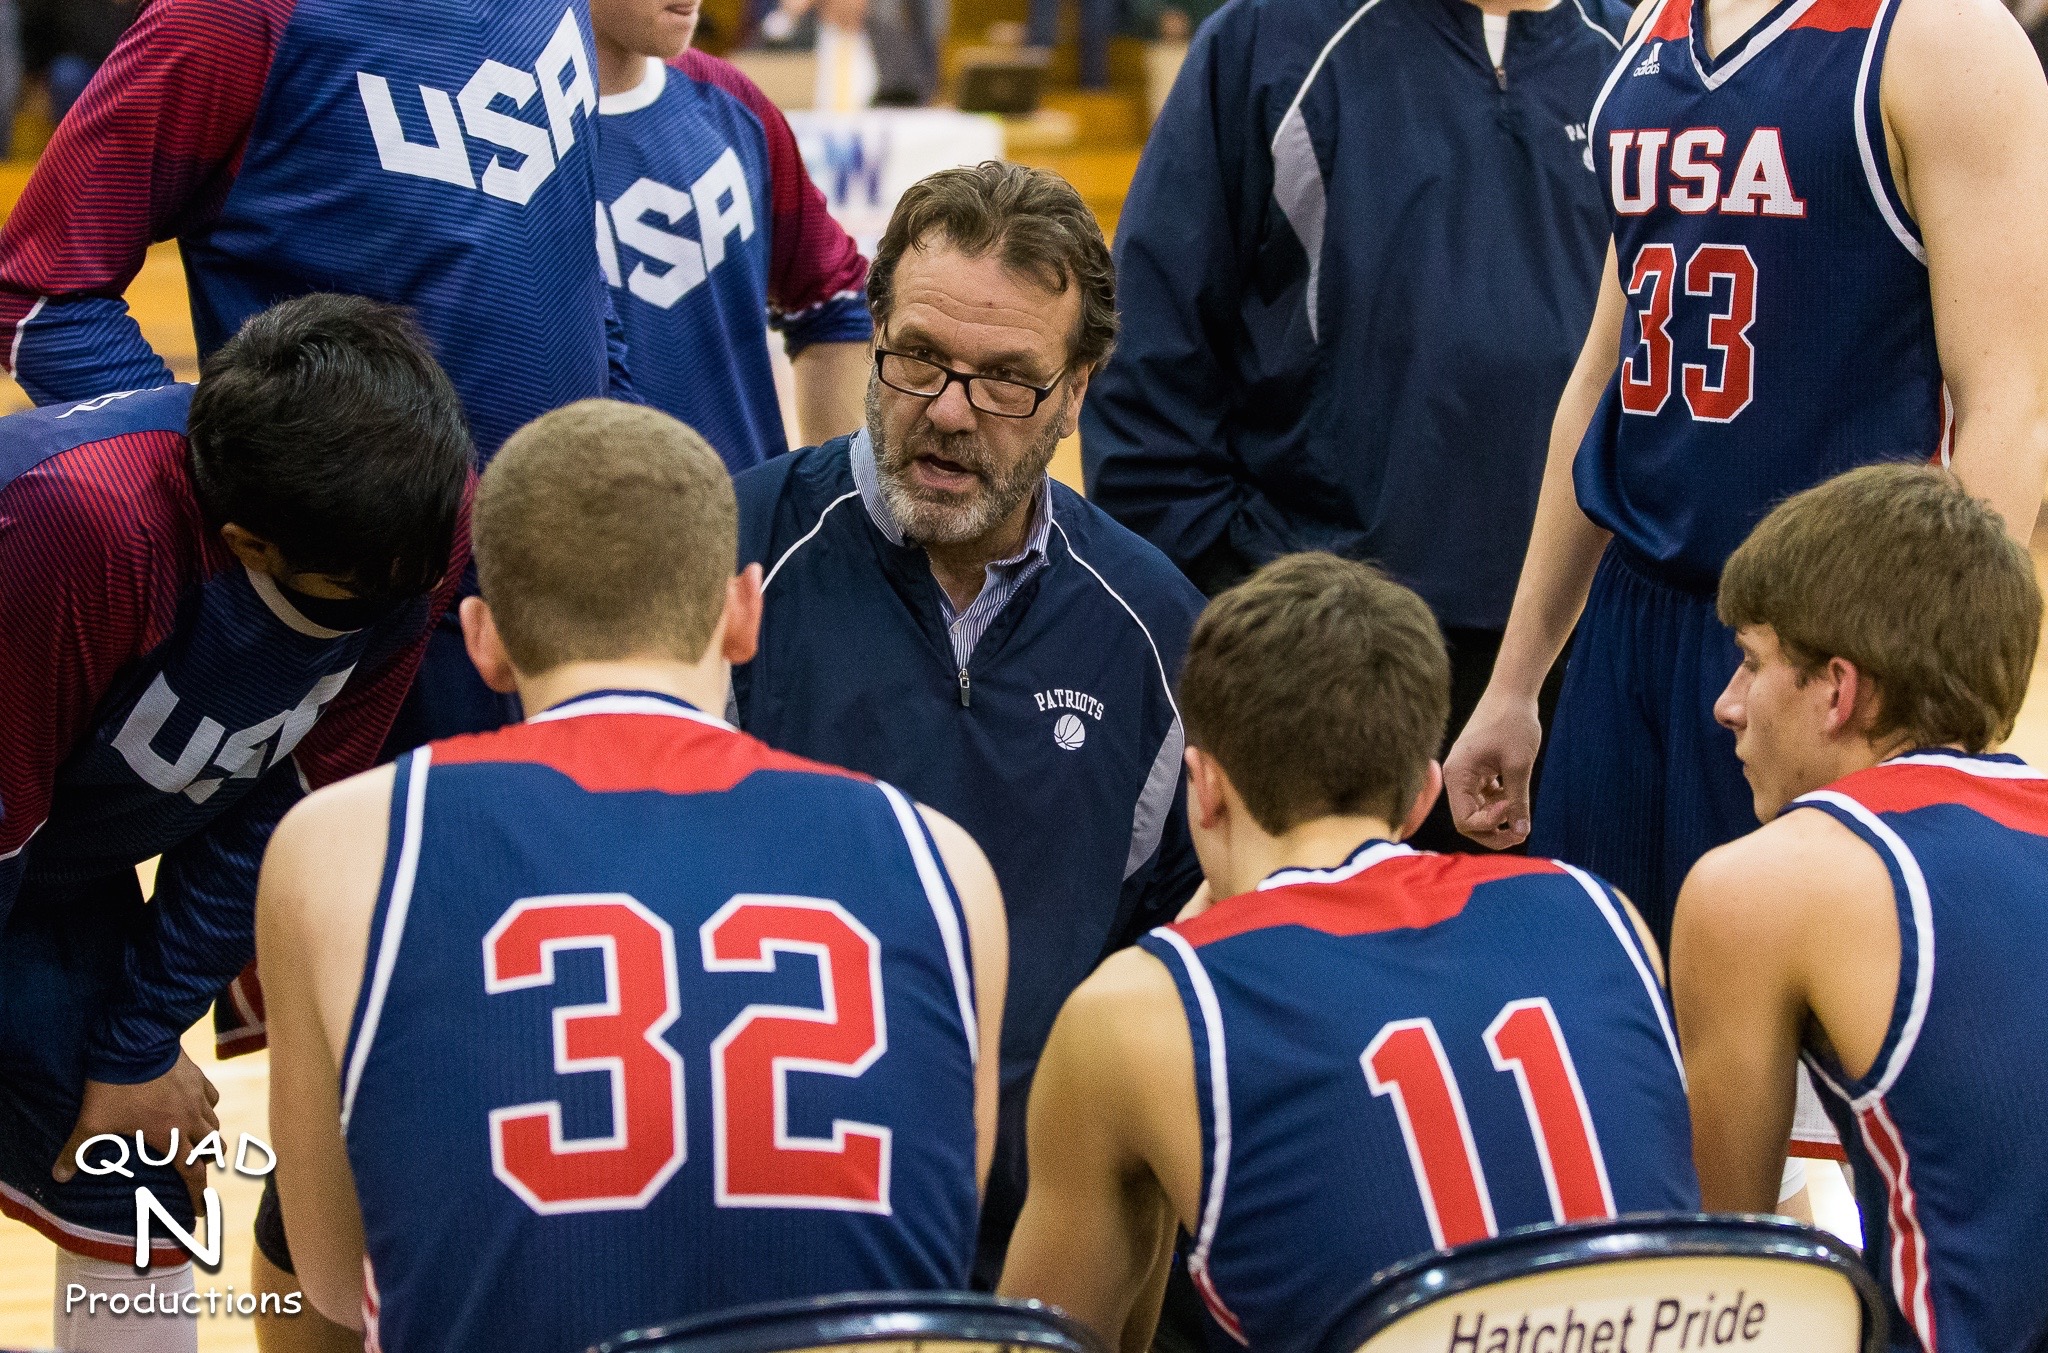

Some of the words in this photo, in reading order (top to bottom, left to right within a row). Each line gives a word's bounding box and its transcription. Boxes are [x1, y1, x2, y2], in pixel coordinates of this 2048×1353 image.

[357, 7, 596, 205] USA
[1633, 62, 1660, 78] adidas
[1609, 127, 1806, 218] USA
[1620, 243, 1758, 423] 33
[1034, 689, 1104, 720] PATRIOTS
[483, 893, 891, 1216] 32
[1360, 997, 1617, 1251] 11
[1449, 1306, 1634, 1353] Hatchet
[1650, 1290, 1766, 1353] Pride
